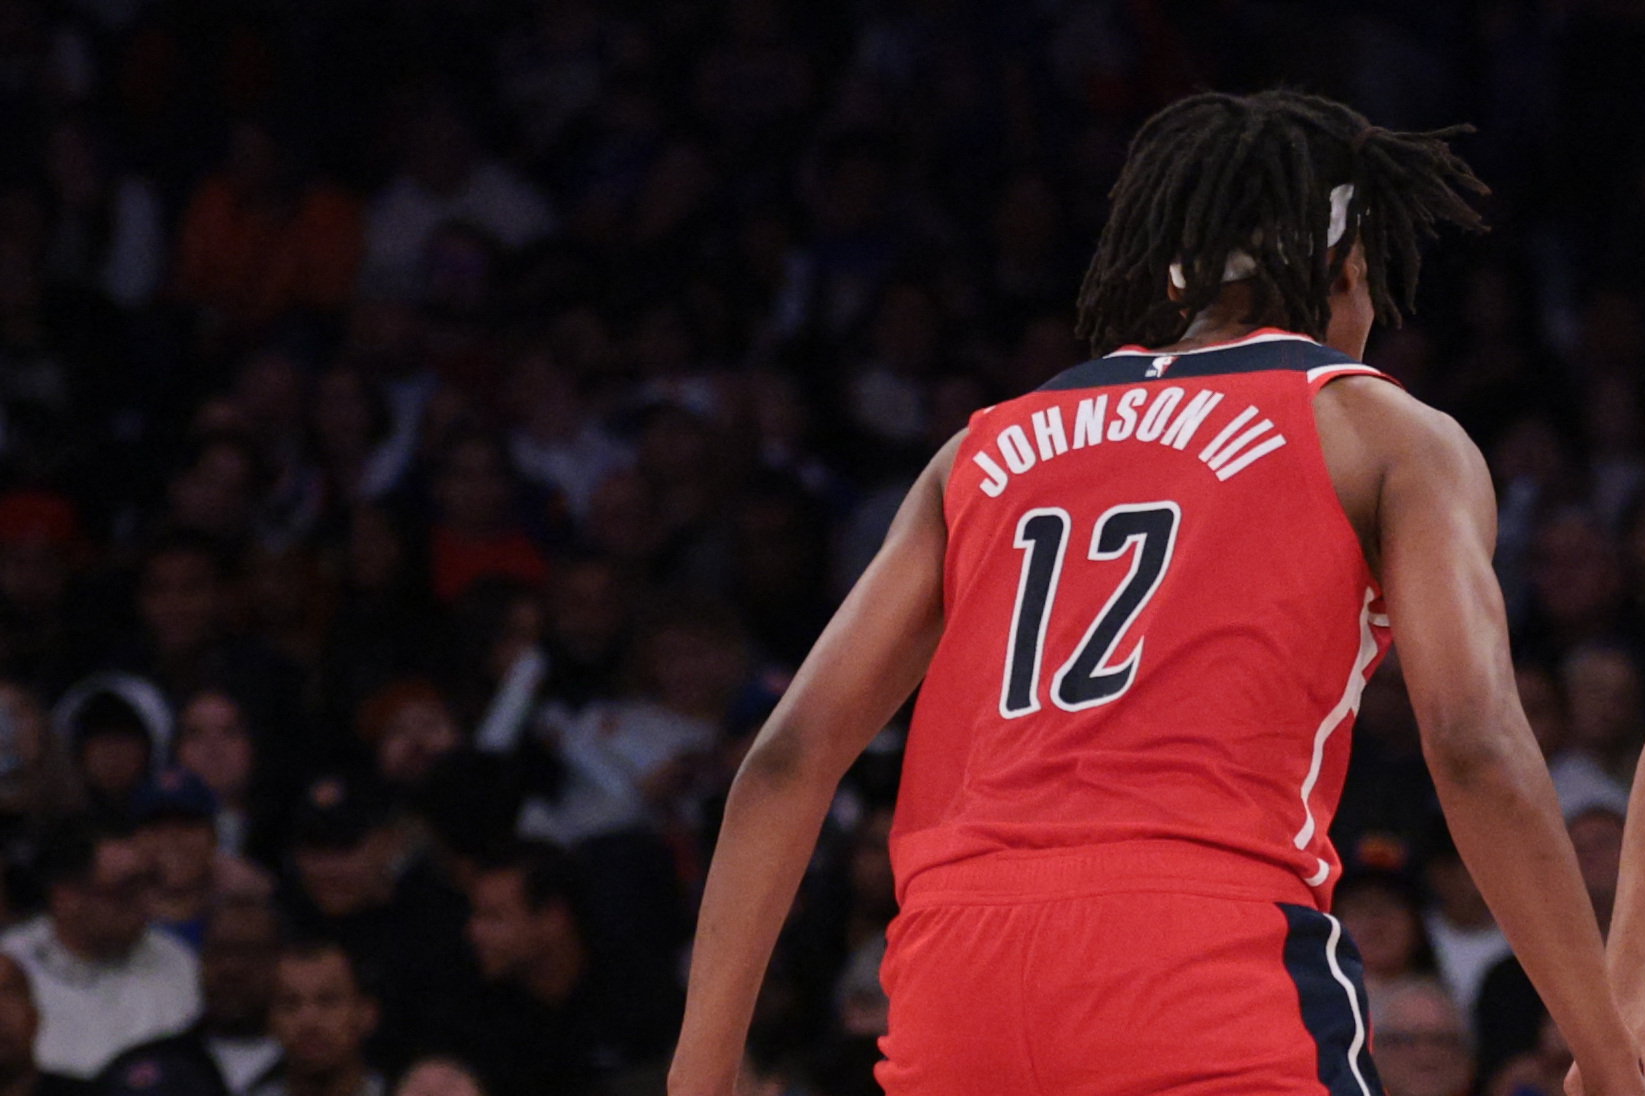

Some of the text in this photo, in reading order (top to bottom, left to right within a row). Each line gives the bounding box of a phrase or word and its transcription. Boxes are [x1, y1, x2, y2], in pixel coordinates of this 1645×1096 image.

[973, 386, 1287, 498] JOHNSON III
[999, 500, 1182, 720] 12
